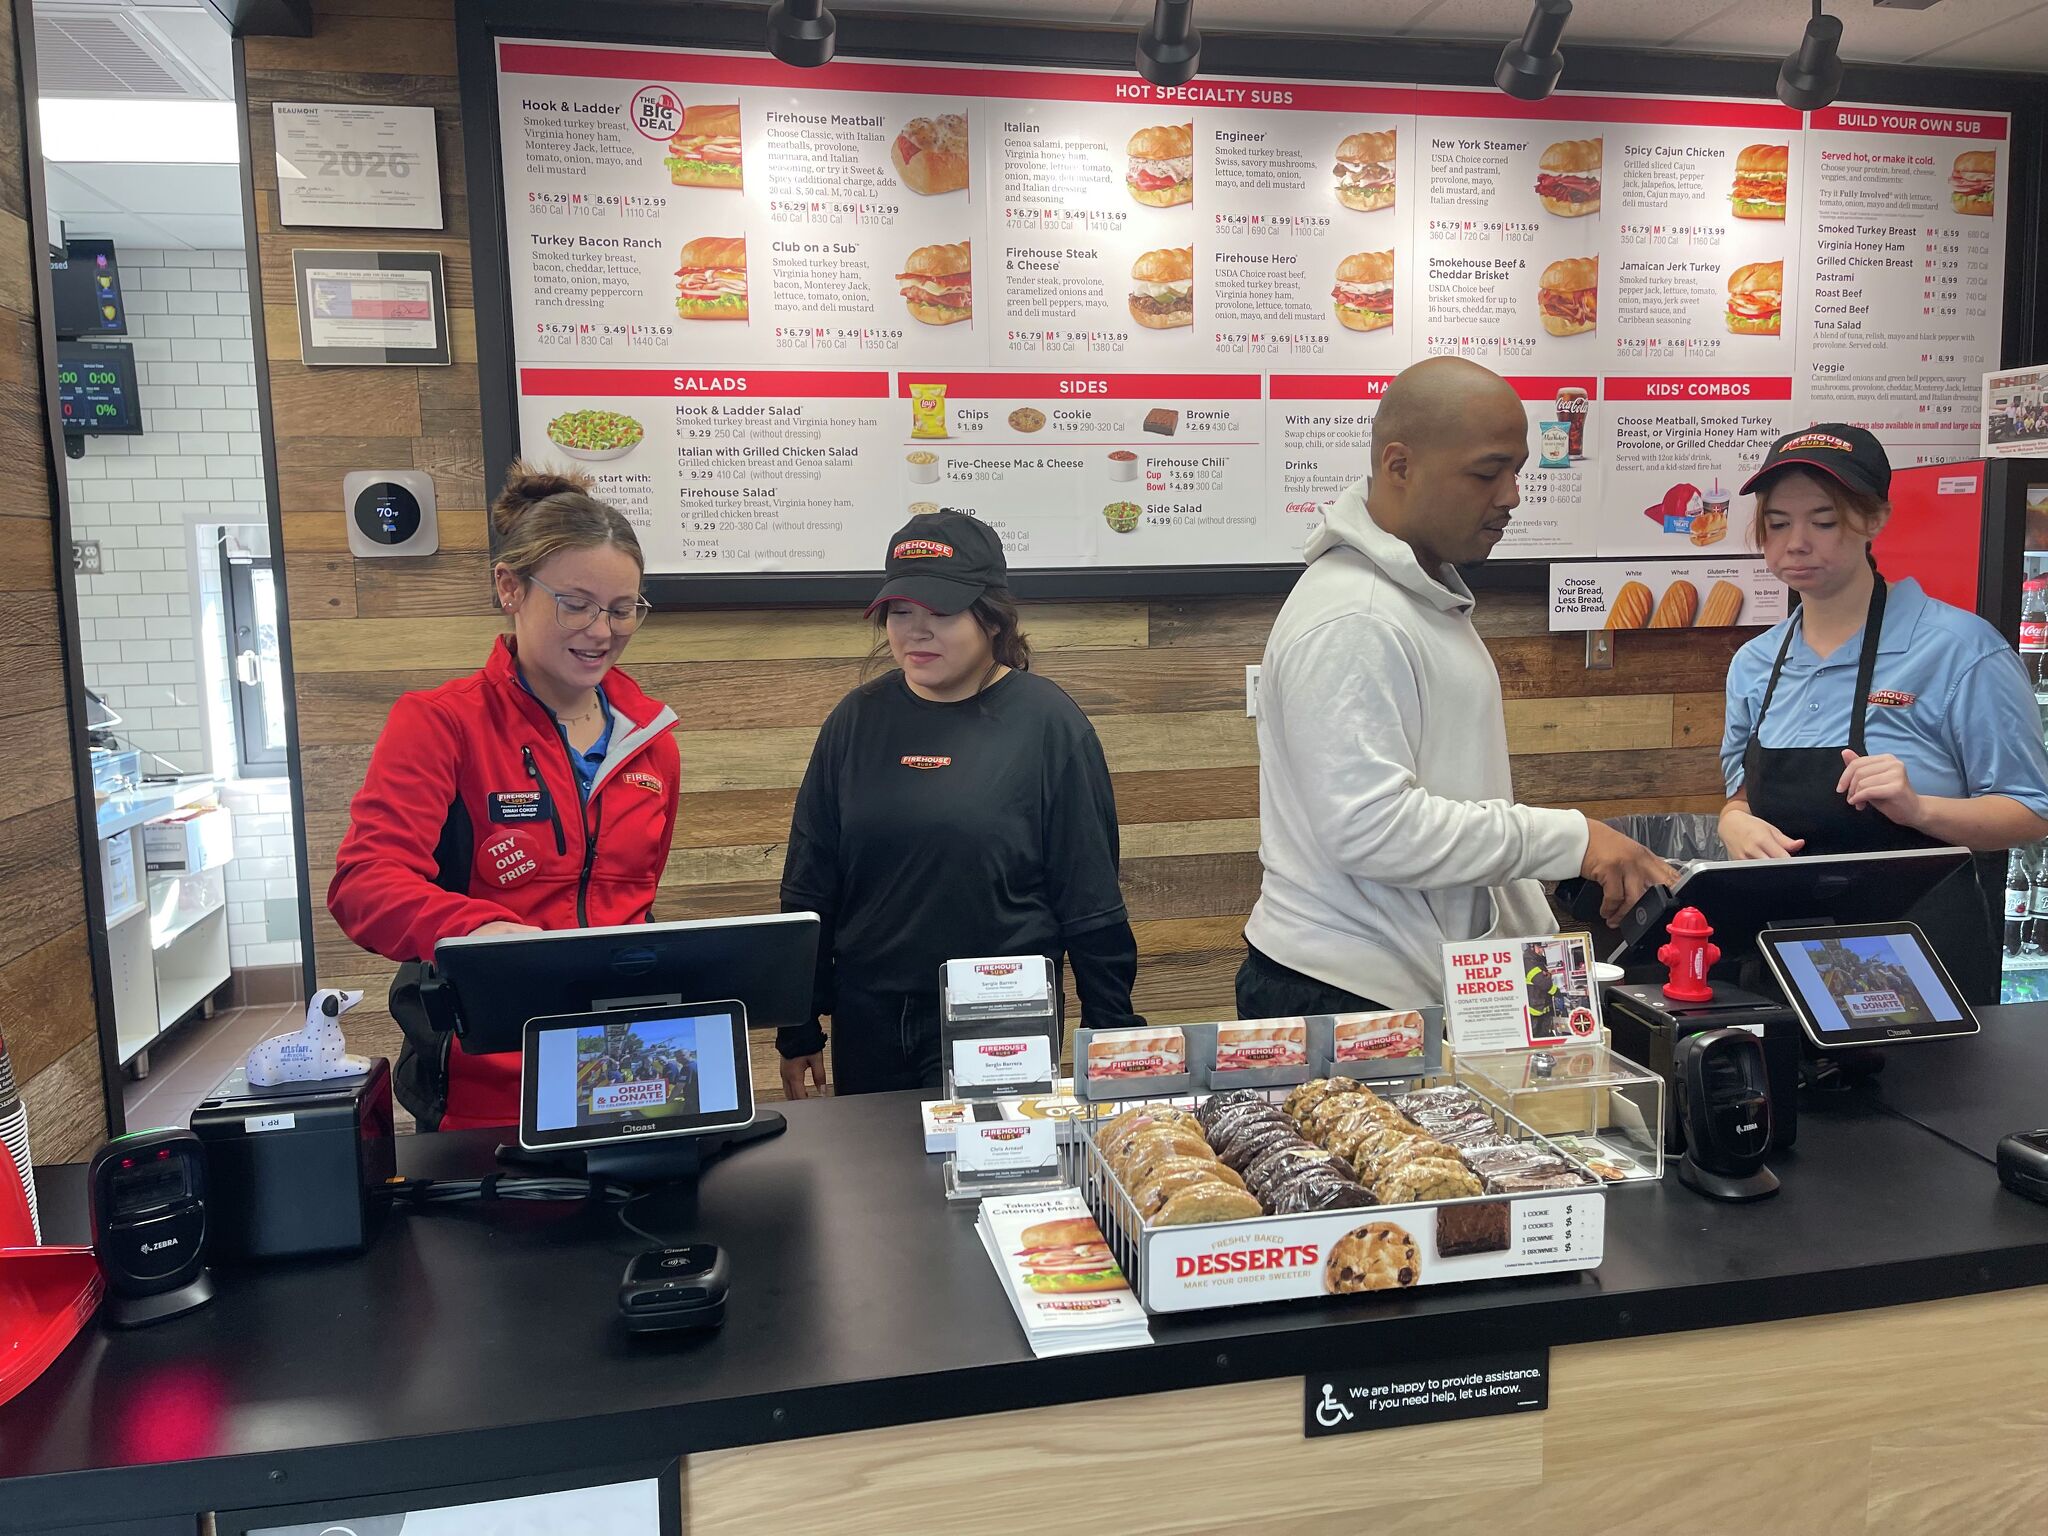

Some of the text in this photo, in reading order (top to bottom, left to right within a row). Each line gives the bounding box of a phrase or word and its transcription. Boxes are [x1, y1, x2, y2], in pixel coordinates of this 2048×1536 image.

[1116, 84, 1292, 104] HOT SPECIALTY SUBS
[640, 96, 656, 105] THE
[277, 107, 318, 115] BEAUMONT
[643, 104, 672, 119] BIG
[523, 116, 628, 130] Smoked turkey breast,
[640, 117, 675, 132] DEAL
[1004, 121, 1040, 134] Italian
[1838, 113, 1980, 132] BUILD YOUR OWN SUB
[524, 128, 620, 142] Virginia honey ham,
[1624, 145, 1724, 157] Spicy Cajun Chicken
[316, 150, 412, 178] 2026
[1821, 152, 1851, 161] Served
[1853, 153, 1870, 163] hot,
[1883, 155, 1905, 164] make
[1908, 155, 1913, 164] it
[1915, 156, 1935, 165] cold.
[1818, 224, 1916, 236] Smoked Turkey Breast
[530, 234, 661, 248] Turkey Bacon Ranch
[1817, 240, 1904, 252] Virginia Honey Ham
[1429, 257, 1525, 268] Smokehouse Beef &
[1620, 261, 1720, 273] Jamaican Jerk Turkey
[1815, 256, 1912, 267] Grilled Chicken Breast
[1429, 269, 1508, 279] Cheddar Brisket
[1816, 272, 1854, 281] Pastrami
[1814, 320, 1861, 329] Tuna Salad
[1812, 363, 1844, 372] Veggie
[89, 372, 116, 384] 0:00
[674, 377, 746, 390] SALADS
[1060, 380, 1107, 394] SIDES
[1647, 383, 1749, 395] KIDS' COMBOS
[96, 404, 116, 416] 0%
[922, 400, 936, 408] Lay's
[957, 409, 988, 420] Chips
[1053, 409, 1091, 418] Cookie
[1186, 410, 1229, 418] Brownie
[1617, 416, 1772, 426] Choose Meatball, Smoked Turkey
[678, 446, 857, 456] Italian with Grilled Chicken Salad
[947, 458, 1083, 468] Five-Cheese Mac & Cheese
[1285, 460, 1317, 469] Drinks
[1146, 470, 1161, 480] Cup
[1146, 482, 1165, 490] Bowl
[1147, 503, 1201, 513] Side Salad
[895, 541, 951, 555] FIREHOUSE
[1578, 587, 1604, 596] Bread,
[1578, 596, 1604, 604] Bread,
[1567, 605, 1578, 613] No
[1580, 604, 1606, 612] Bread.
[498, 792, 540, 801] FIREHOUSE
[488, 836, 515, 857] TRY
[496, 849, 525, 869] OUR
[499, 860, 536, 884] FRIES
[1452, 952, 1511, 967] HELP US
[976, 964, 1022, 973] FIREHOUSE
[1465, 967, 1502, 980] HELP
[1457, 980, 1514, 995] HEROES
[1863, 994, 1897, 1002] ORDER
[1862, 1001, 1900, 1010] DONATE
[980, 1045, 1026, 1054] FIREHOUSE
[619, 1084, 662, 1094] ORDER
[610, 1091, 663, 1103] DONATE
[632, 1123, 656, 1132] toast
[982, 1128, 1030, 1137] FIREHOUSE
[154, 1238, 178, 1250] ZEBRA
[1211, 1234, 1284, 1249] FRESHLY BAKED
[1176, 1244, 1318, 1278] DESSERTS
[1184, 1270, 1311, 1289] MAKE YOUR ORDER SWEETER!
[1349, 1369, 1540, 1398] We are happy to provide assistance.
[1369, 1384, 1520, 1410] If you need help, let us know.
